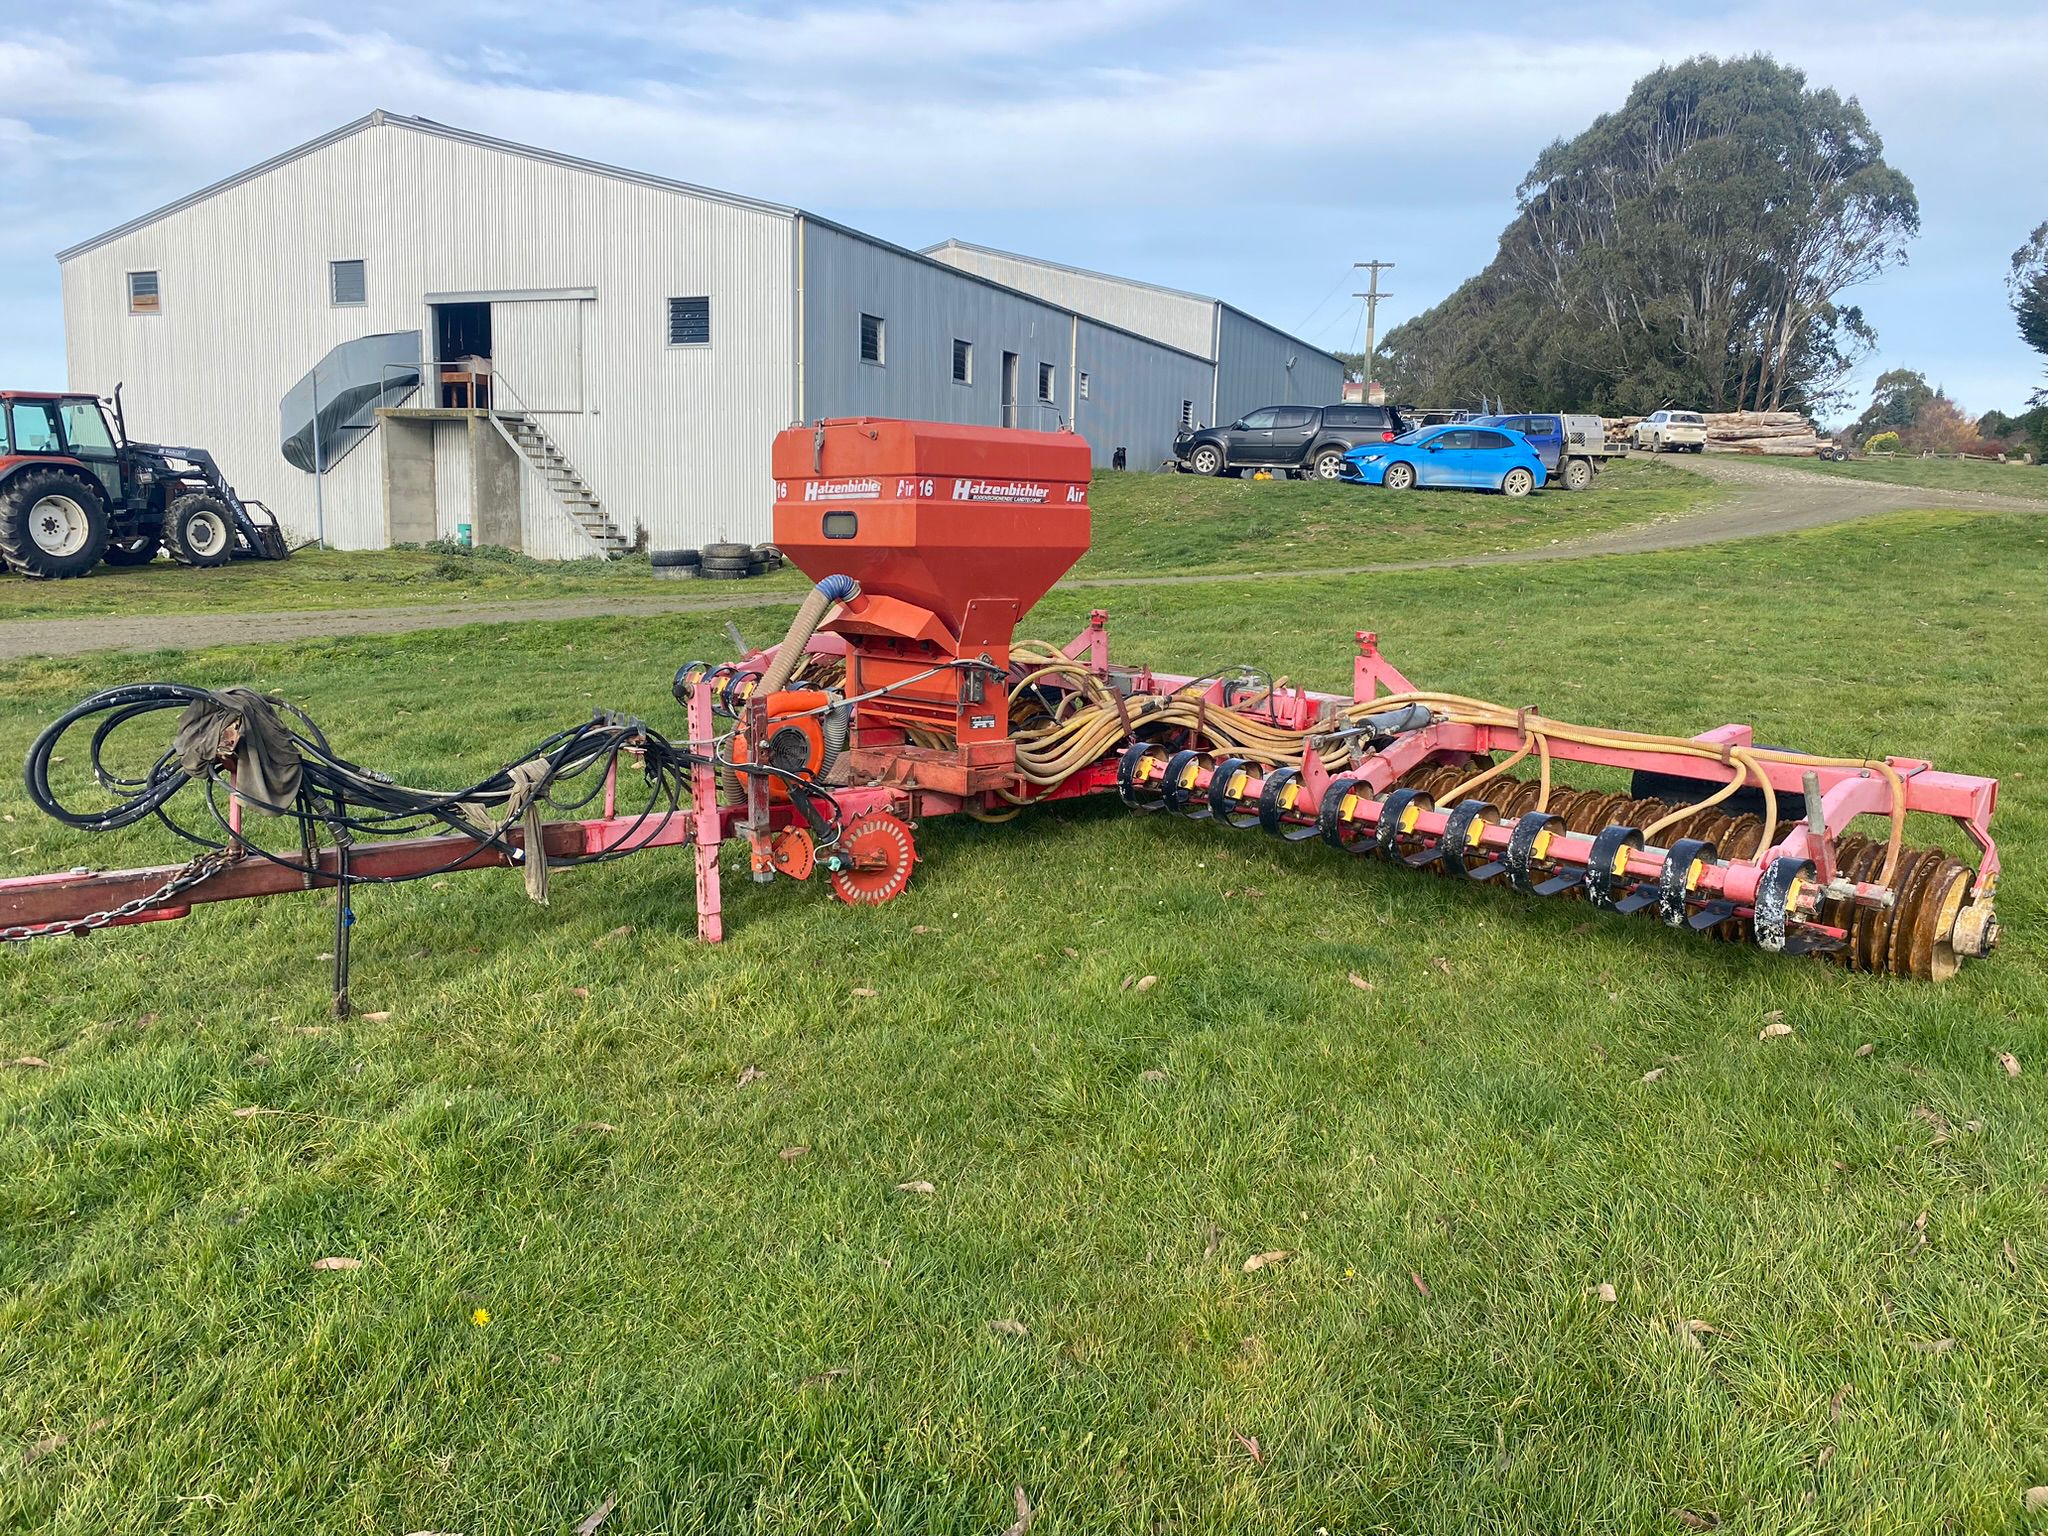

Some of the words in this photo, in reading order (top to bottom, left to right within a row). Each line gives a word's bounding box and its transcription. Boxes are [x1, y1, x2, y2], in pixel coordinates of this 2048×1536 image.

[777, 481, 787, 498] 16
[896, 479, 915, 497] Air
[919, 479, 934, 497] 16
[952, 479, 1050, 500] Hatzenbichler
[1066, 486, 1084, 502] Air
